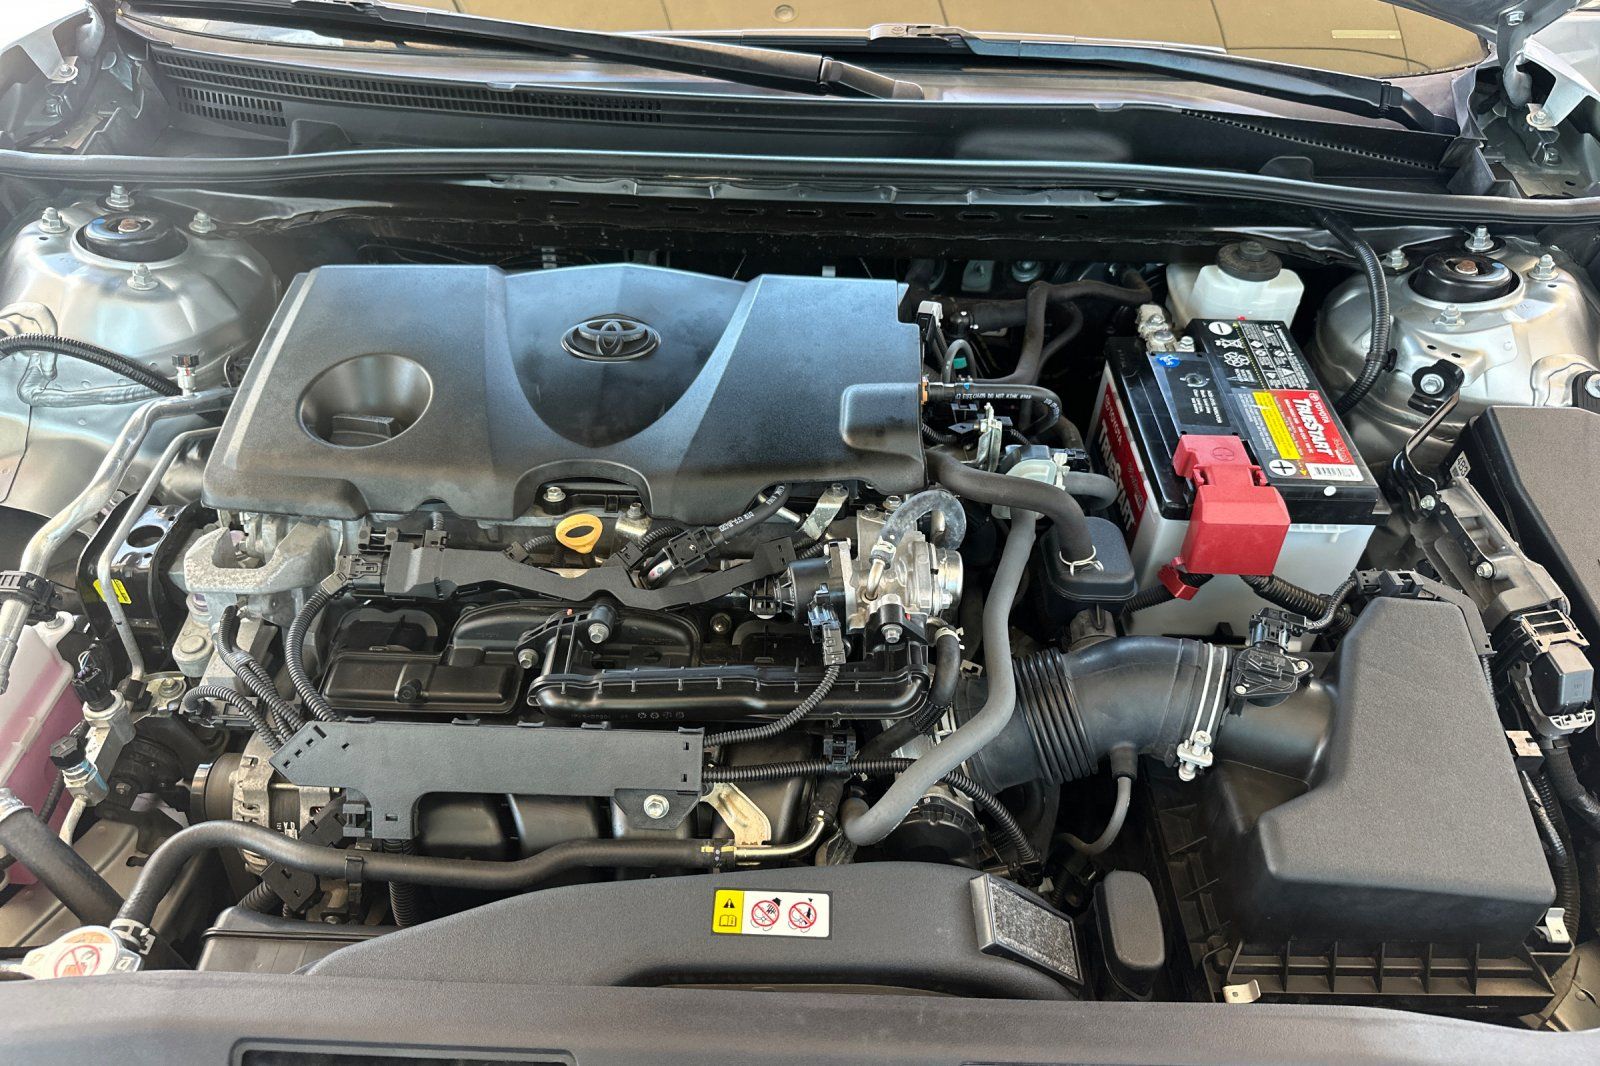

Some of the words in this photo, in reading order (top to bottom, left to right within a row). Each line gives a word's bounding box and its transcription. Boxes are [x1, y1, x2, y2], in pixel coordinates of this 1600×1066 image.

[1314, 401, 1330, 424] TOYOTA
[1108, 409, 1122, 446] TOYOTA
[1458, 456, 1468, 477] 4B3
